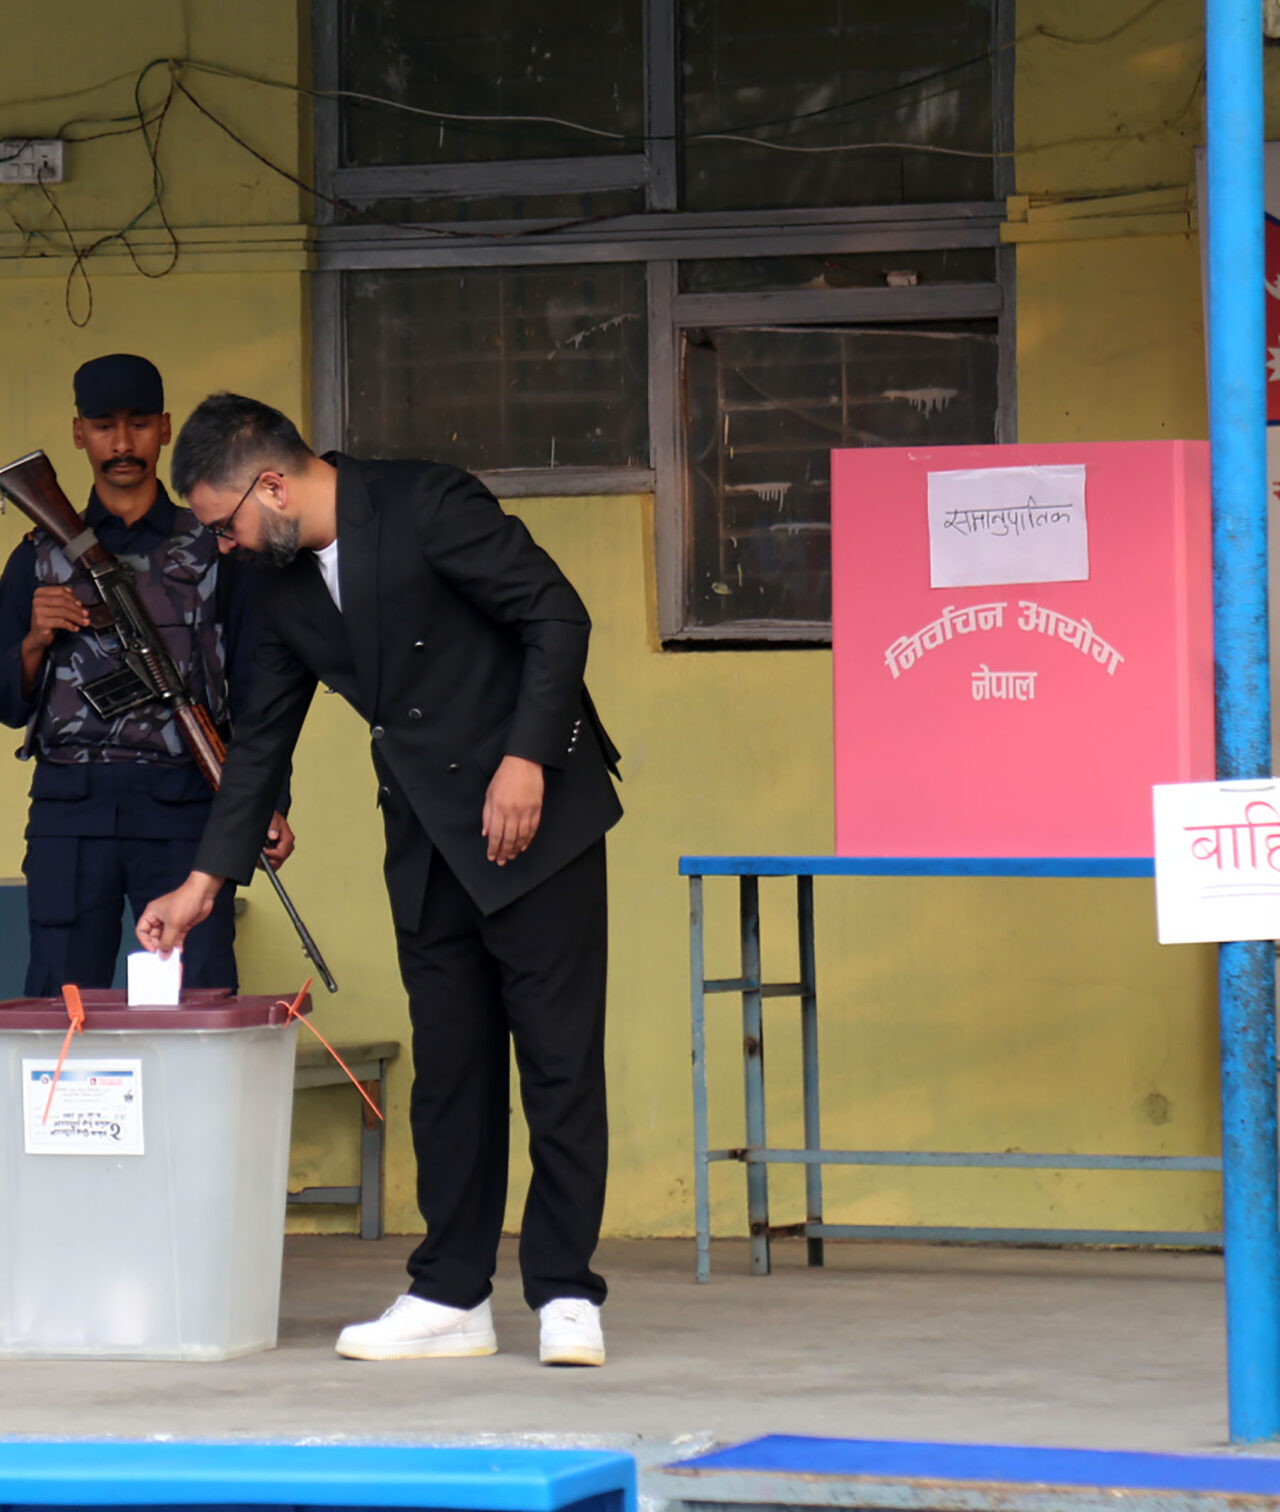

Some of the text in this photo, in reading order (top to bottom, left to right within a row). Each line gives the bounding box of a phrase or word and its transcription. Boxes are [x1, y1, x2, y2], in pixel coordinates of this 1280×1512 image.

[943, 495, 1073, 536] समानुपातिक
[884, 600, 1125, 679] निर्वाचन आयोग
[971, 664, 1038, 701] नेपाल
